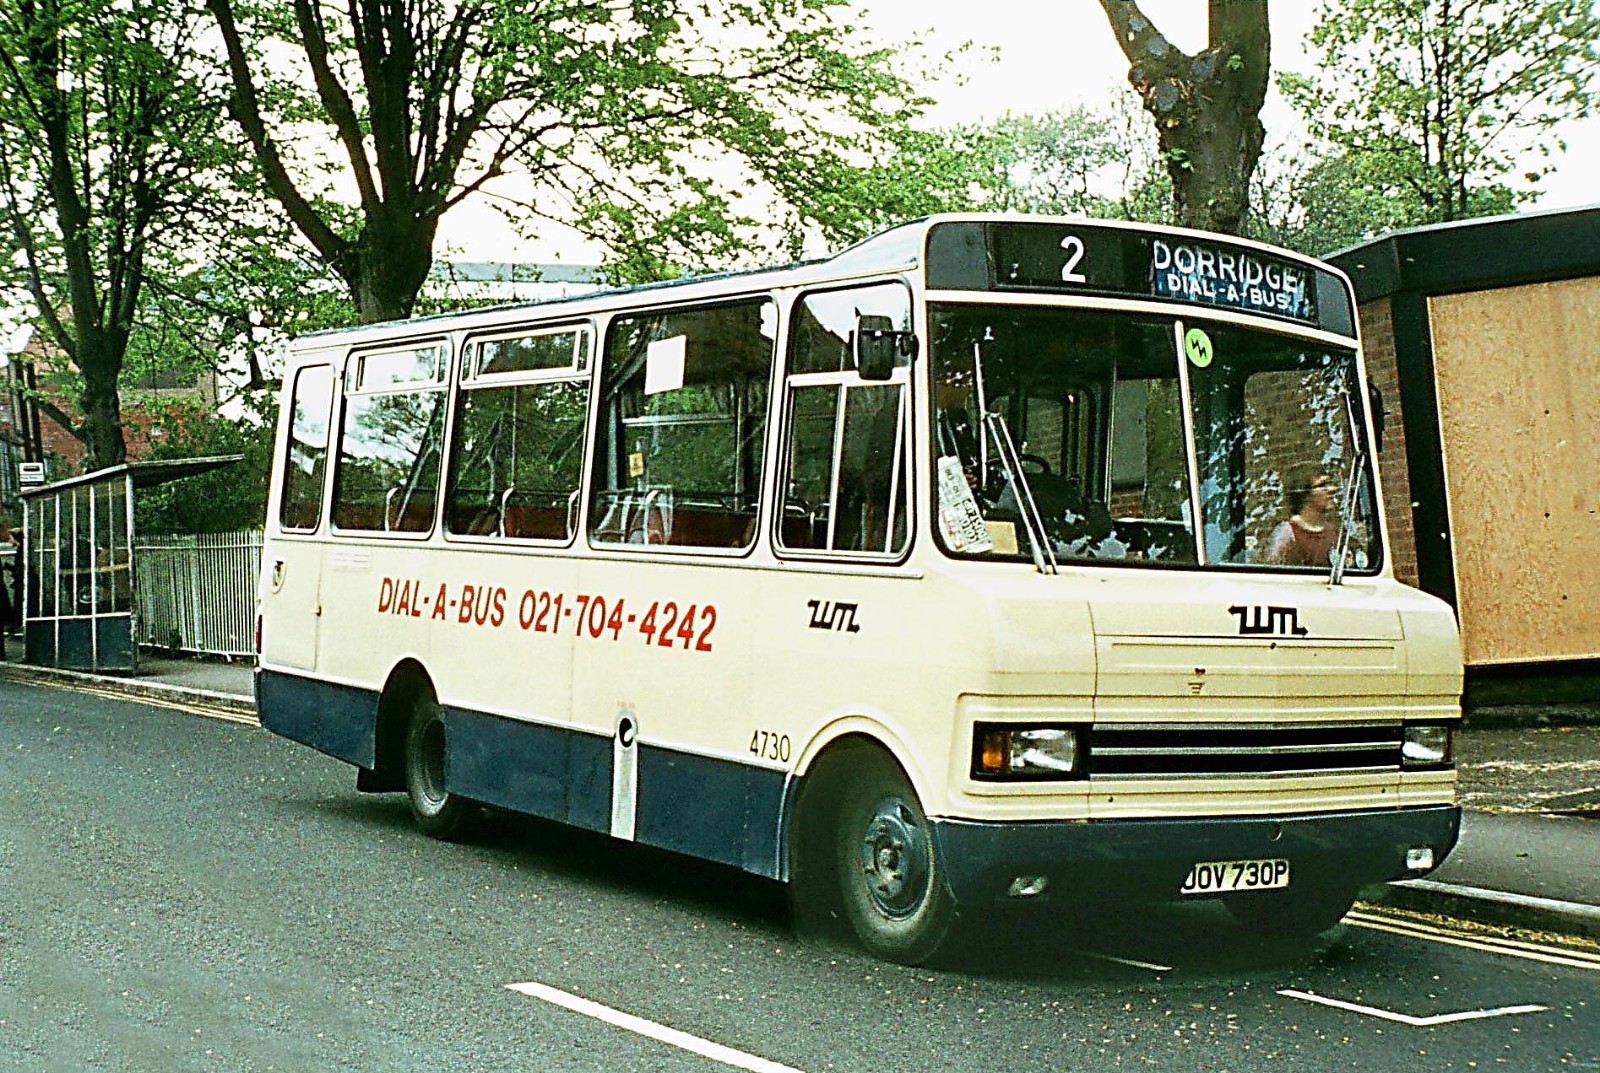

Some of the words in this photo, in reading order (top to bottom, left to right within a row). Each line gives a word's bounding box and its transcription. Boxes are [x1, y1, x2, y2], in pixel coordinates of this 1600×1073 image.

[1060, 235, 1086, 284] 2
[1153, 239, 1299, 294] DORRIDGE
[378, 577, 507, 628] DIAL-A-BUS
[518, 589, 717, 652] 021-704-4242
[749, 729, 791, 762] 4730
[1183, 864, 1226, 890] JOV
[1231, 860, 1288, 887] 730P
